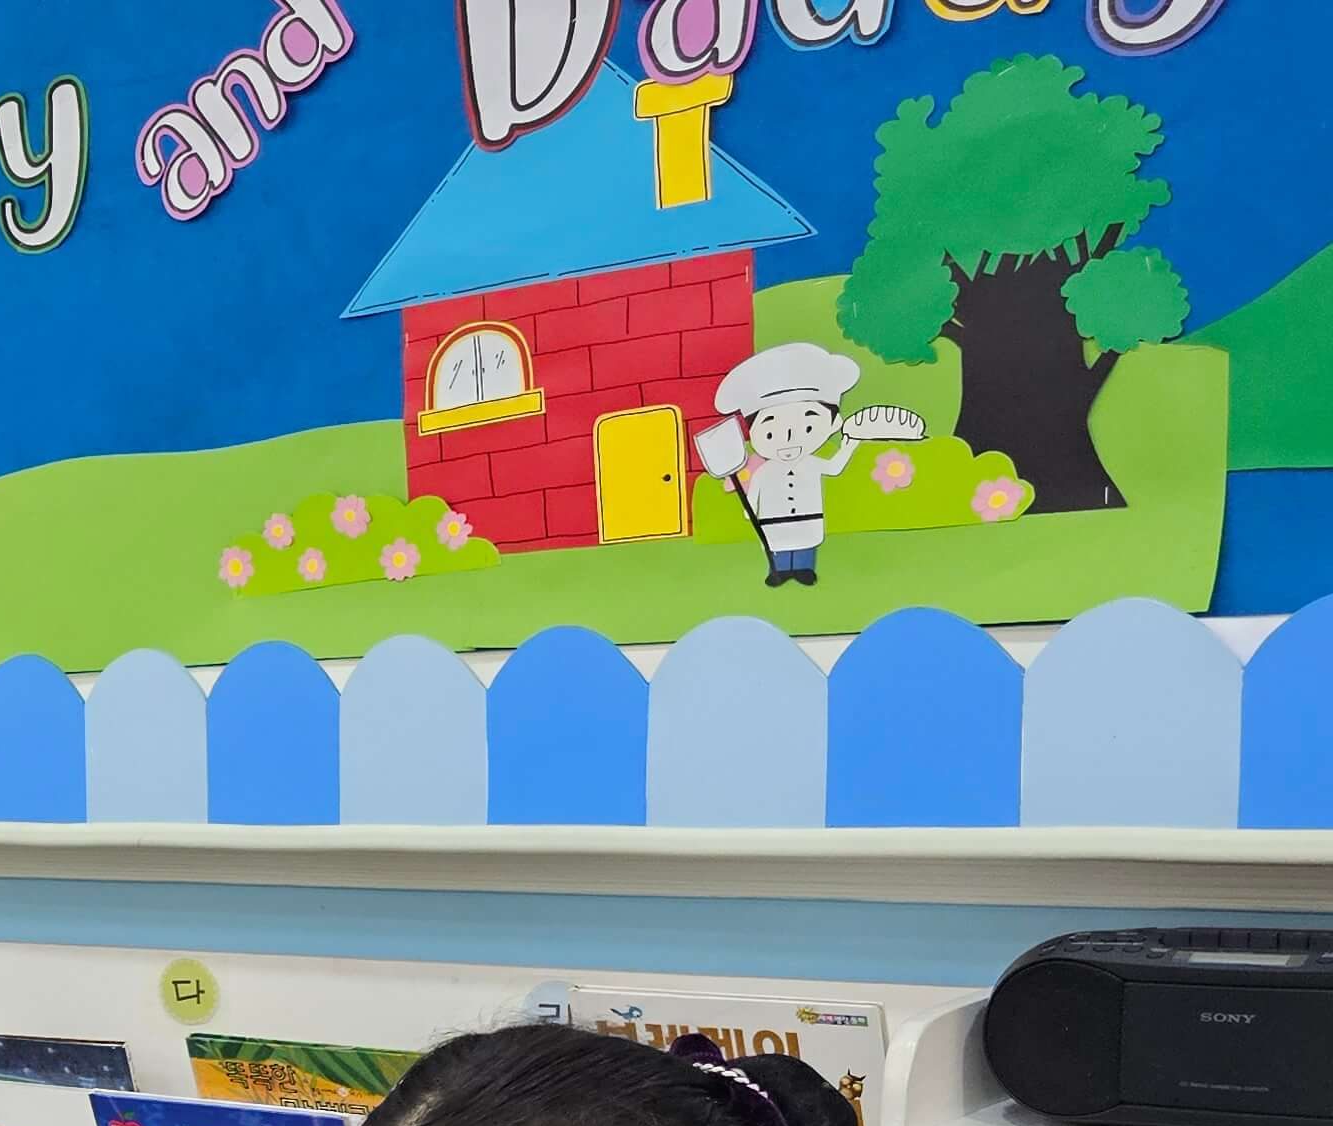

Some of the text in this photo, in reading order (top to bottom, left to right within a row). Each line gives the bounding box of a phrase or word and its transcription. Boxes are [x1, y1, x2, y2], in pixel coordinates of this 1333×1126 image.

[135, 0, 355, 221] and
[171, 979, 206, 1005] 다
[1199, 1012, 1257, 1025] SONY
